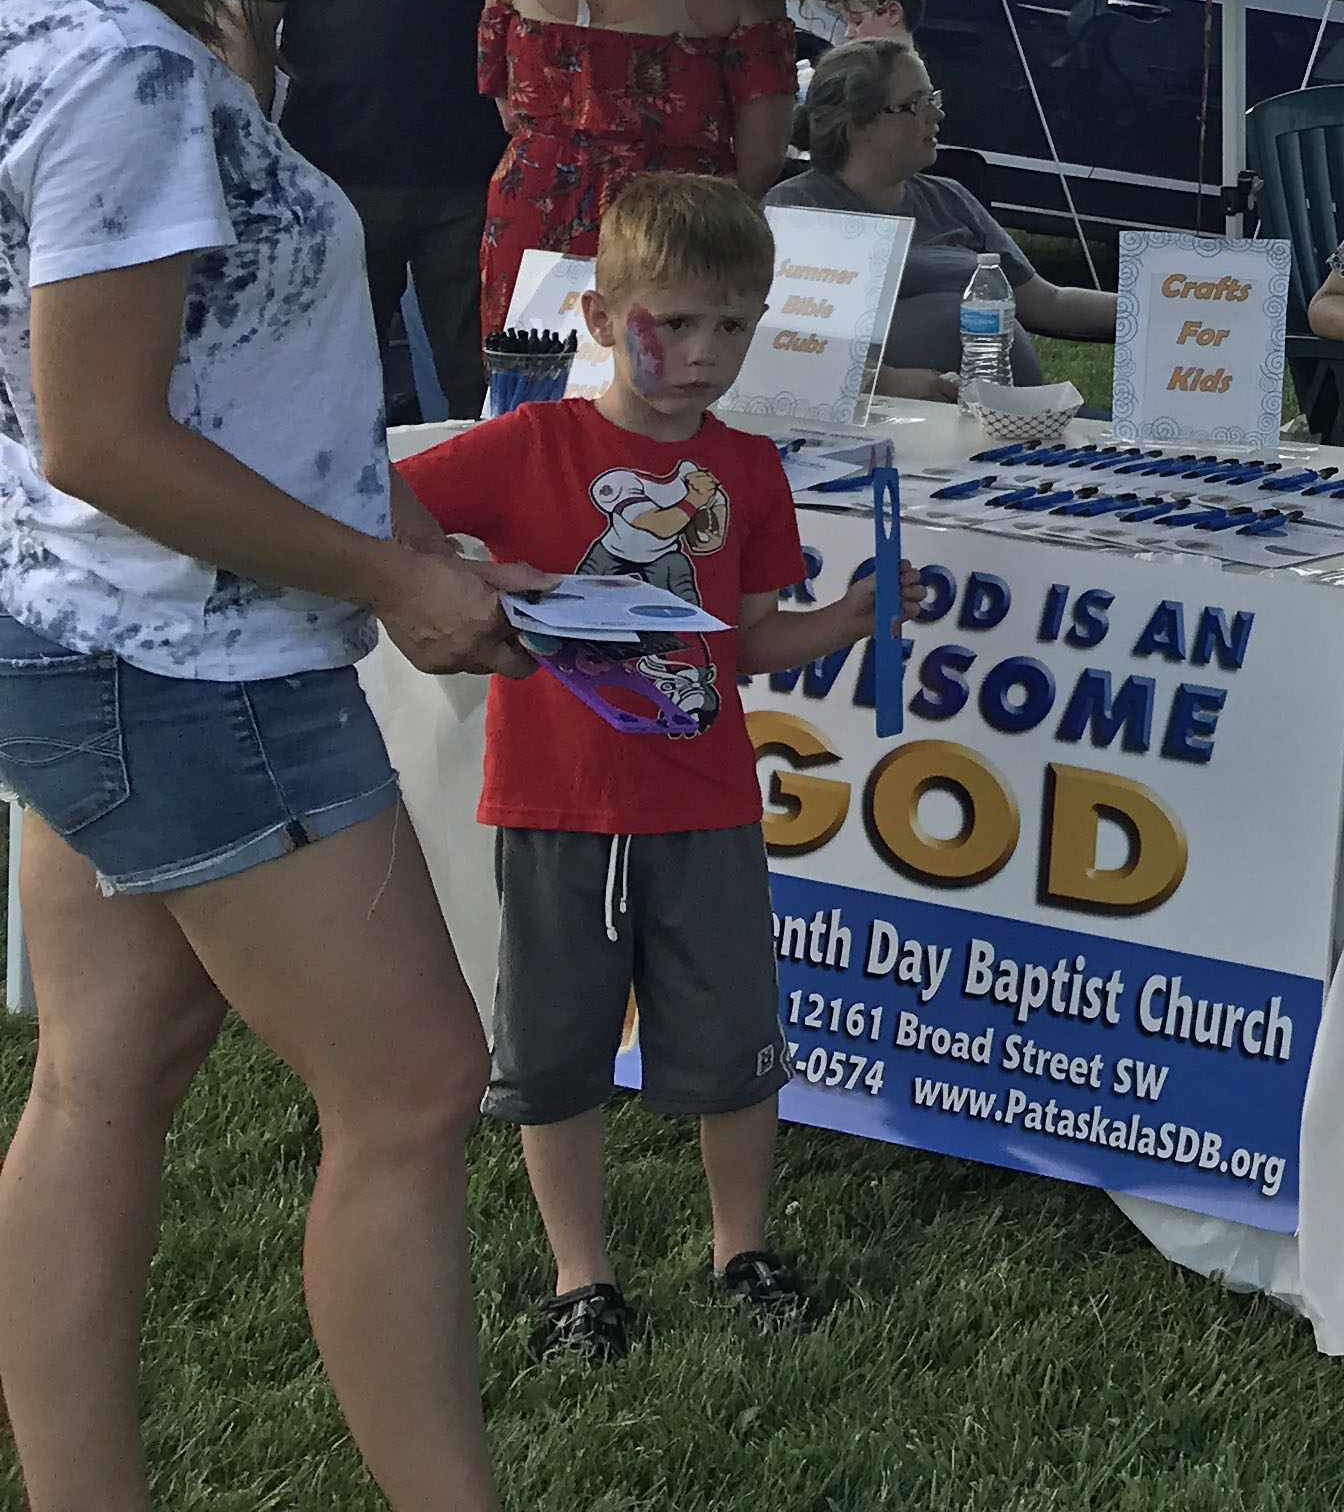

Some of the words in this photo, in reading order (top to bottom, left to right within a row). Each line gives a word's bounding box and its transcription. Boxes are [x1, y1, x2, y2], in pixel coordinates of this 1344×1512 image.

[773, 330, 828, 354] Clubs
[1161, 273, 1252, 302] Crafts
[1176, 320, 1230, 346] For
[1166, 366, 1233, 393] Kids
[849, 556, 1012, 630] OD
[1035, 583, 1116, 648] IS
[1131, 600, 1256, 671] AN
[741, 710, 1188, 916] GOD
[866, 919, 951, 1001] Day
[964, 938, 1124, 1024] Baptist
[1139, 974, 1293, 1060] Church
[789, 990, 883, 1040] 12161
[896, 1011, 995, 1064] Broad
[1002, 1034, 1104, 1088] Street
[1113, 1057, 1169, 1101] SW
[914, 1076, 1286, 1196] www.PataskalaSDB.org
